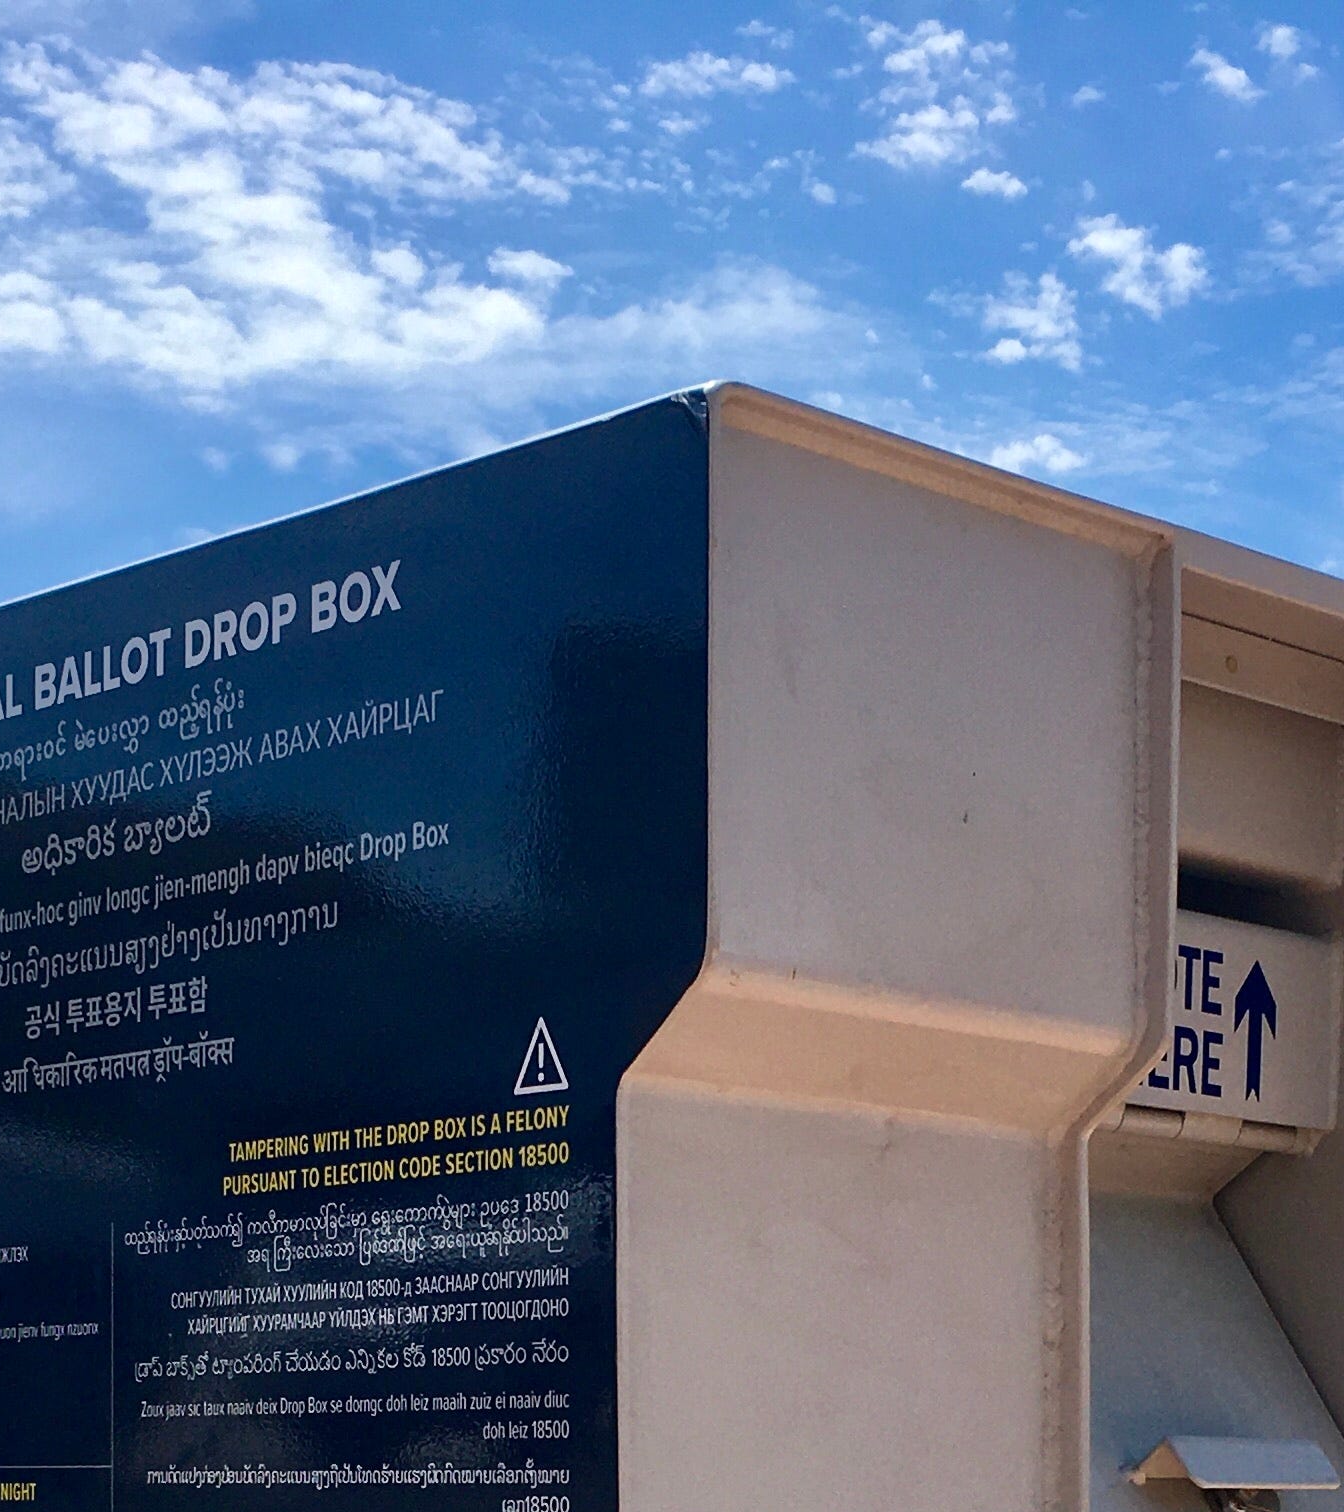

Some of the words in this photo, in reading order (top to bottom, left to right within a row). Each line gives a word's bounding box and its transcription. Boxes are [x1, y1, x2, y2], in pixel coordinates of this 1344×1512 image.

[34, 627, 171, 710] BALLOT
[184, 592, 296, 668] DROP
[311, 559, 401, 633] BOX
[71, 761, 154, 808] ХУУДАС
[159, 736, 253, 787] ХҮЛЭЭЖ
[258, 719, 321, 763] АВАХ
[326, 688, 444, 747] ХАЙРЦАГ
[68, 891, 101, 926] ginv
[106, 885, 150, 914] longc
[153, 858, 250, 910] jien-mengh
[255, 853, 299, 885] dapv
[304, 838, 354, 872] bieqc
[360, 831, 406, 862] Drop
[412, 822, 449, 851] Box
[24, 1000, 60, 1039] 공식
[66, 986, 141, 1033] 투표용지
[147, 975, 208, 1020] 투표함
[1175, 944, 1224, 1016] TE
[228, 1134, 308, 1162] TAMPERING
[313, 1129, 349, 1153] WITH
[354, 1126, 382, 1149] THE
[387, 1121, 429, 1145] DROP
[434, 1116, 466, 1140] BOX
[471, 1114, 485, 1136] IS
[489, 1112, 501, 1134] A
[506, 1104, 569, 1133] FELONY
[223, 1169, 296, 1196] PURSUANT
[301, 1167, 319, 1188] TO
[324, 1159, 394, 1186] ELECTION
[399, 1155, 440, 1179] CODE
[445, 1147, 513, 1174] SECTION
[518, 1141, 569, 1167] 18500
[0, 1482, 36, 1501] NIGHT
